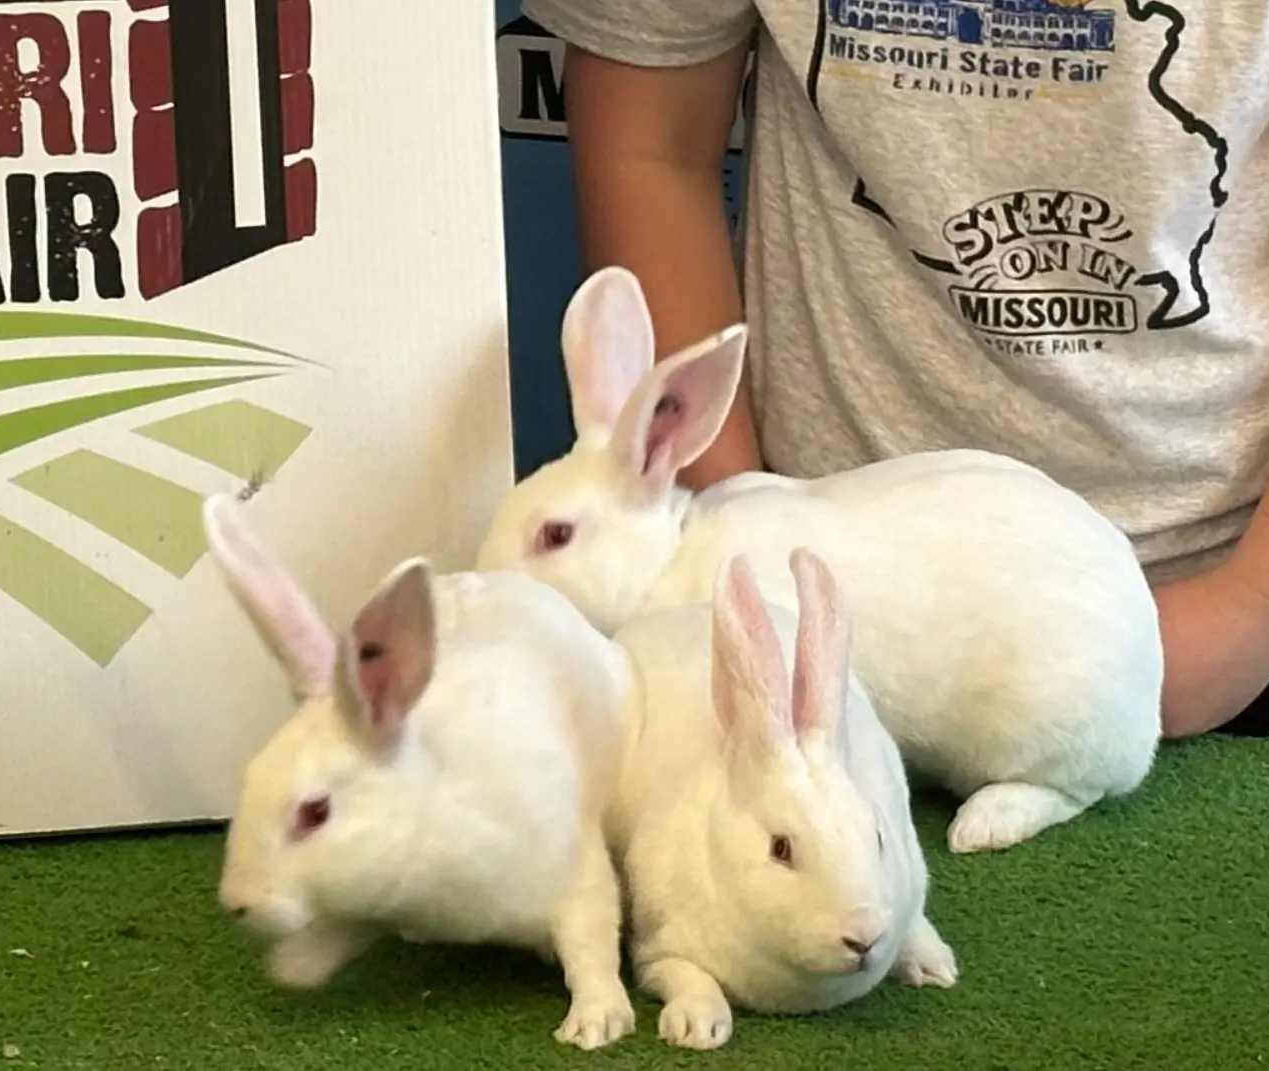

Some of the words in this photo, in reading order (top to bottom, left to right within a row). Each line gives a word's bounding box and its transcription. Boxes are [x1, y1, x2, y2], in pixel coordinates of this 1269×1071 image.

[829, 33, 948, 71] Missouri
[960, 50, 1040, 79] State
[1051, 57, 1109, 83] Fair
[893, 73, 1034, 101] Exhibitor
[943, 189, 1112, 266] STEP
[1000, 240, 1070, 280] ON
[1078, 243, 1137, 291] IN
[958, 294, 1126, 328] MISSOURI
[994, 338, 1045, 355] STATE
[1052, 338, 1090, 354] FAIR
